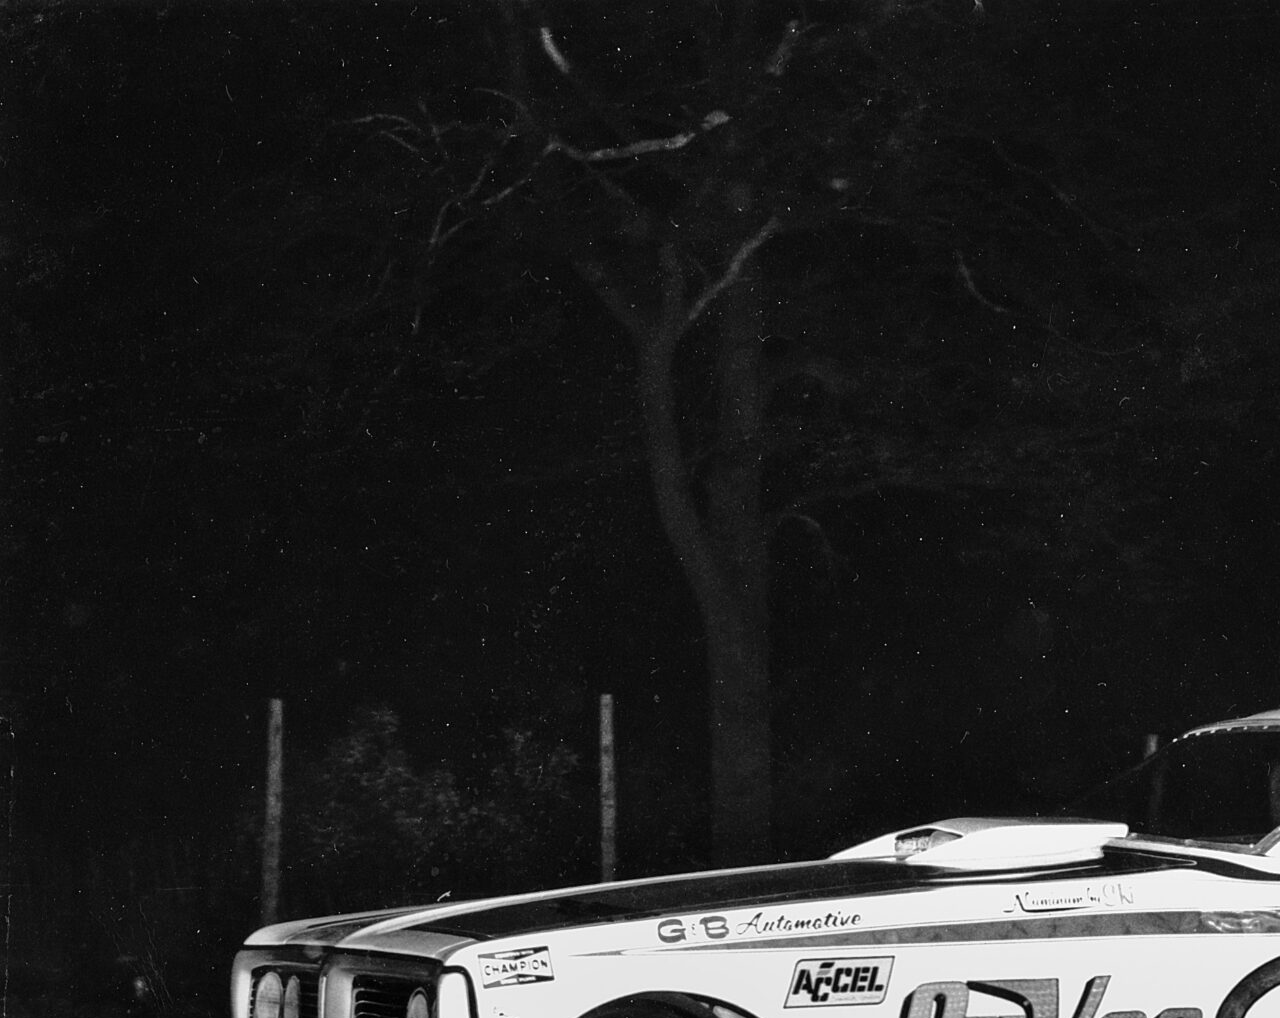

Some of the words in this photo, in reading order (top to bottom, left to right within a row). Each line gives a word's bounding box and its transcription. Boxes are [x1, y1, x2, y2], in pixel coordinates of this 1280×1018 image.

[657, 918, 687, 943] G
[699, 915, 730, 939] B
[736, 911, 862, 934] Automotive
[484, 959, 548, 976] CHAMPION
[792, 962, 884, 1003] ACCEL
